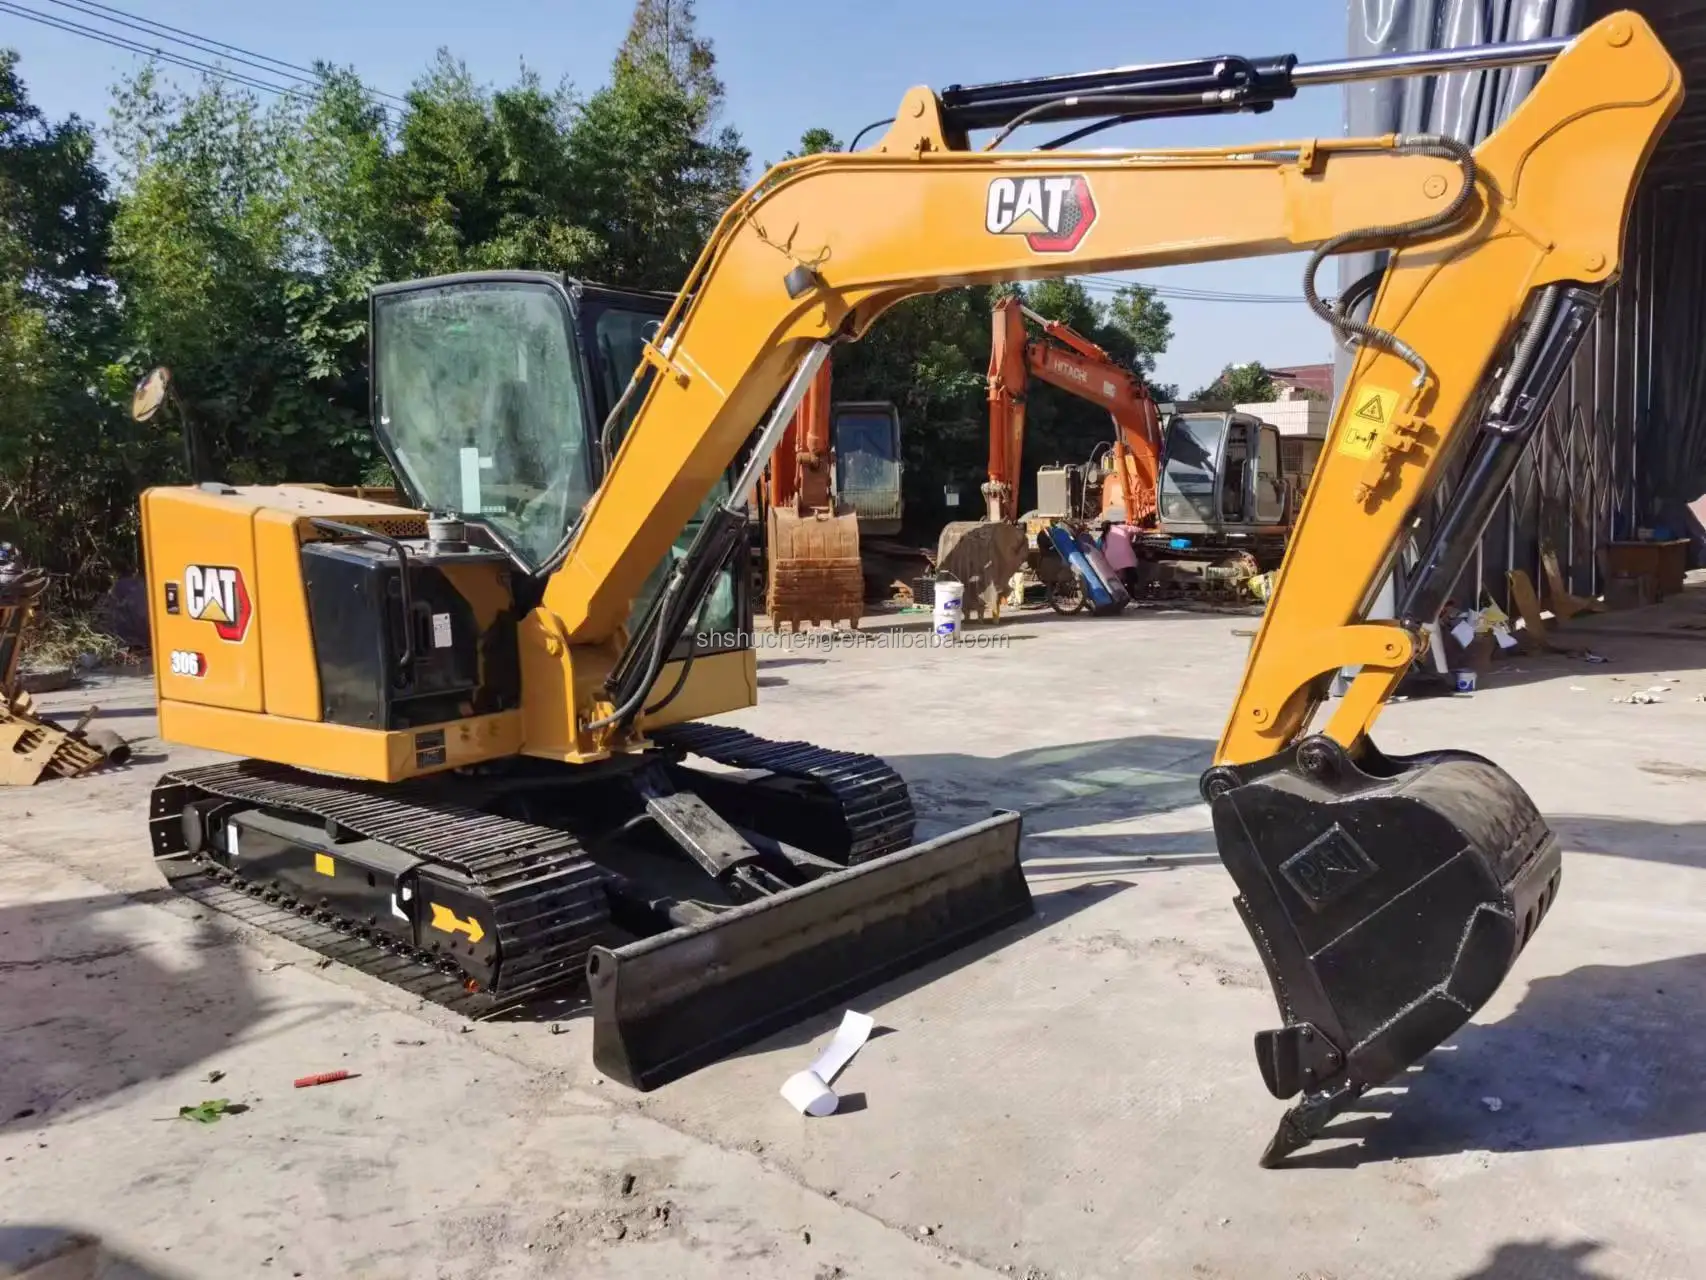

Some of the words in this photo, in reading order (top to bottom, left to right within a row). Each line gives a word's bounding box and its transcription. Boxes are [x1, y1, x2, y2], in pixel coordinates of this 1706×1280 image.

[986, 178, 1071, 234] CAT
[1053, 359, 1088, 383] HITACHI
[185, 565, 236, 622] CAT
[171, 650, 199, 676] 306
